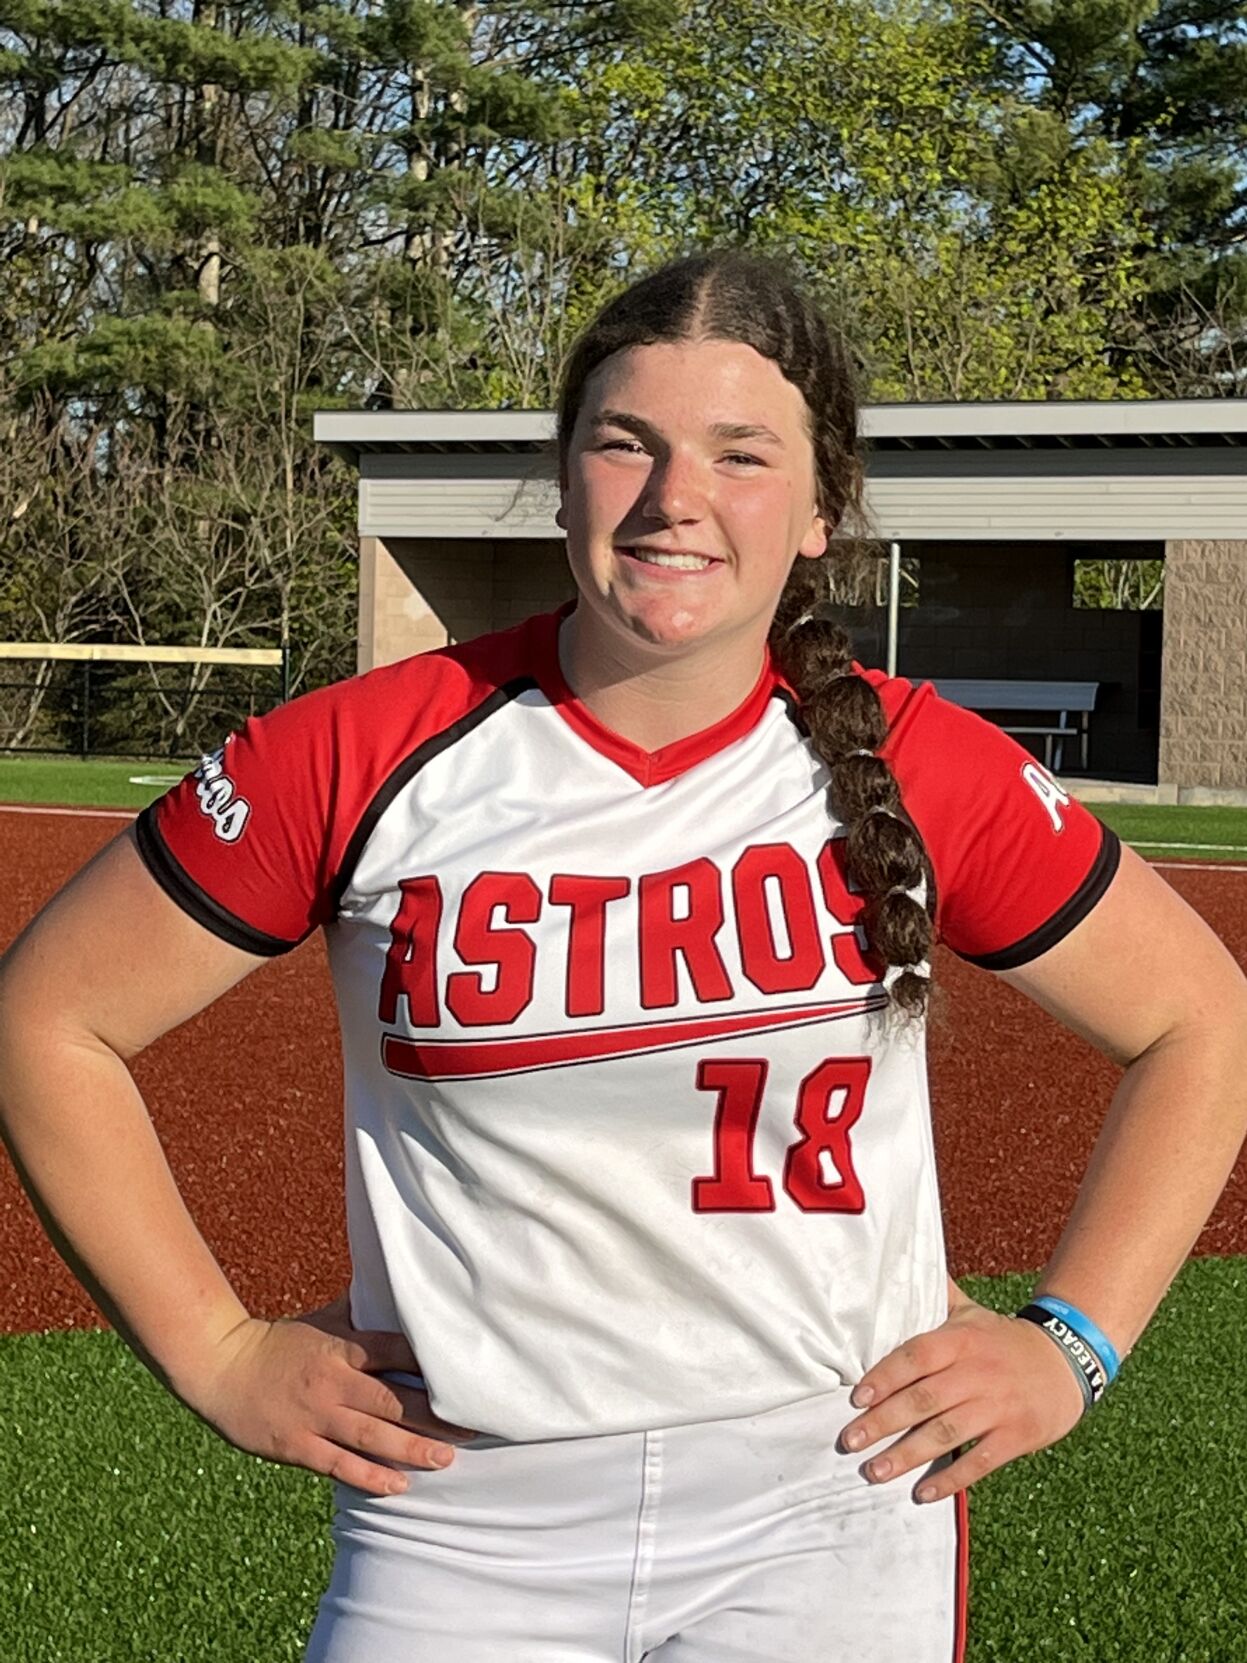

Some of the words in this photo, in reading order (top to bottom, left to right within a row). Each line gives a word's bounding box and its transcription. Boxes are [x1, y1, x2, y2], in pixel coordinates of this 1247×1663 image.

[379, 838, 887, 1028] ASTROS
[691, 1056, 873, 1214] 18
[1042, 1317, 1097, 1375] LEGACY
